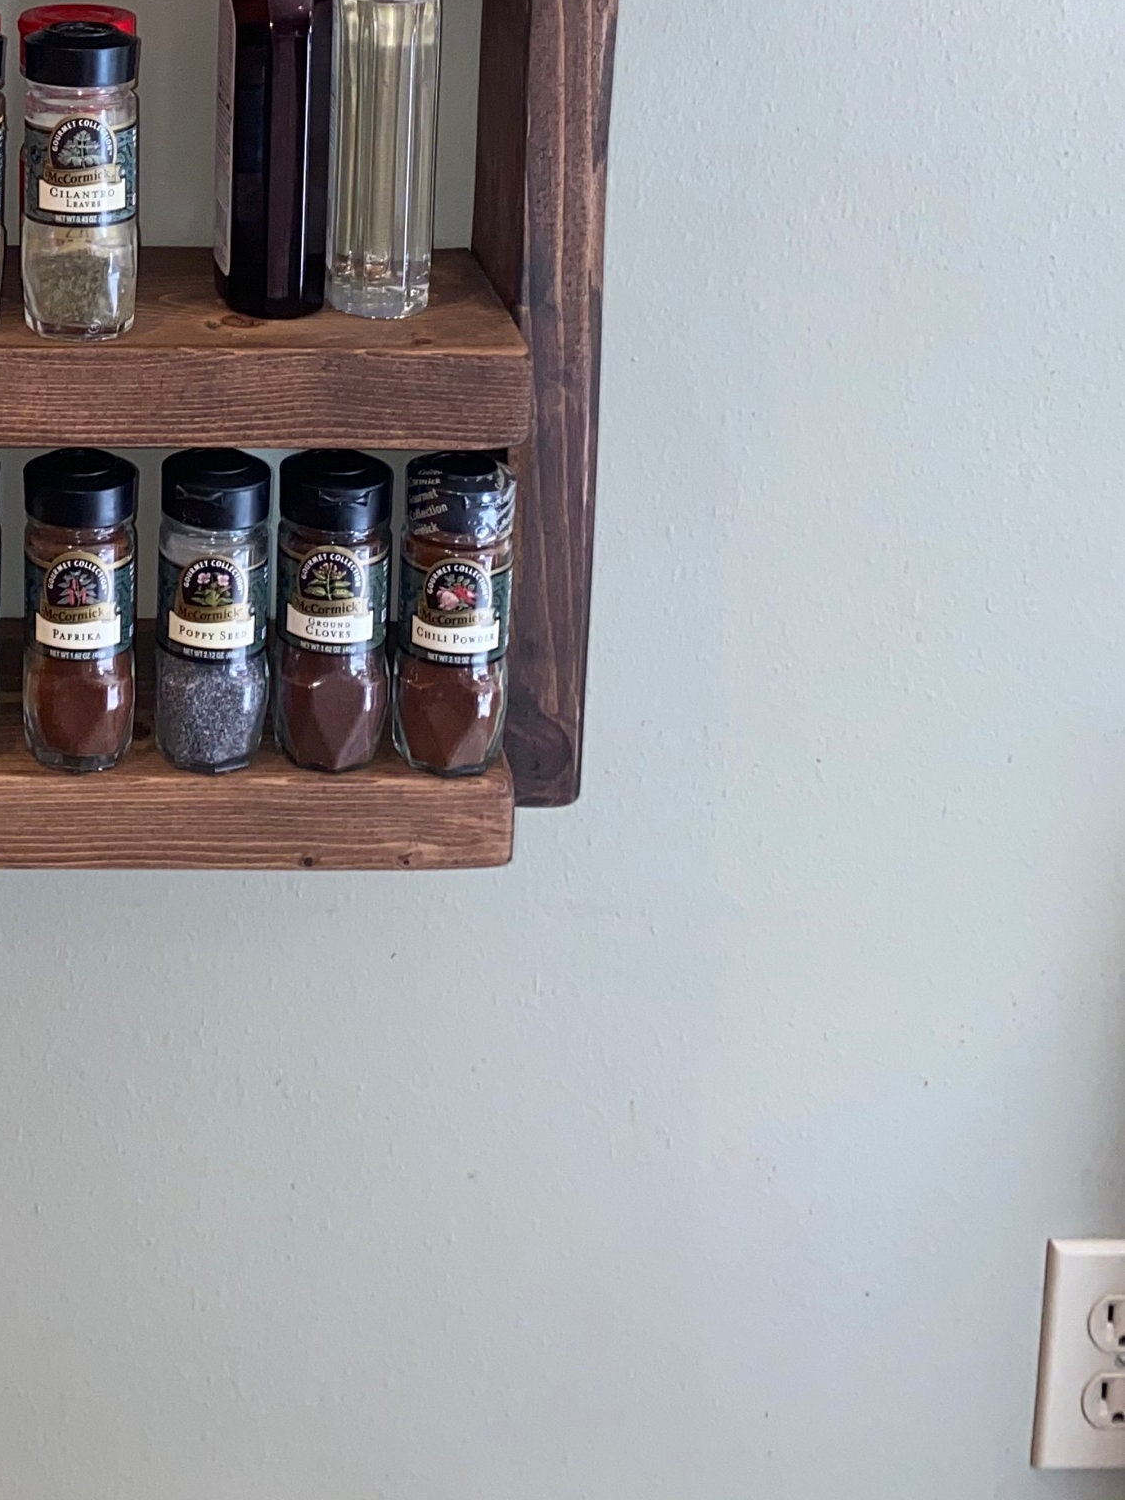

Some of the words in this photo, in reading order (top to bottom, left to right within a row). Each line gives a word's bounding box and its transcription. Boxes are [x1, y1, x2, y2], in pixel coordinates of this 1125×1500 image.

[52, 120, 76, 152] GOURMET
[45, 169, 112, 184] McCormick
[49, 186, 115, 199] CILANTRO
[66, 200, 101, 208] LEAVES
[47, 560, 72, 589] GOURMET
[74, 559, 108, 591] COLLECTION
[183, 560, 209, 588] GOURMET
[211, 559, 243, 591] COLLECTION
[301, 553, 327, 580] GOURMET
[330, 553, 362, 587] COLLECTION
[427, 564, 451, 594] GOURMET
[454, 564, 489, 596] COLLECTION
[42, 606, 103, 622] McCormick
[177, 605, 239, 620] McCormick
[421, 609, 484, 625] McCormick
[308, 617, 351, 628] GROUND
[52, 628, 102, 641] PAPRIKA
[179, 624, 215, 641] POPPY
[219, 631, 247, 641] SEED
[305, 625, 351, 638] CLOVES
[416, 626, 447, 643] CHILI
[453, 633, 494, 644] POWDER
